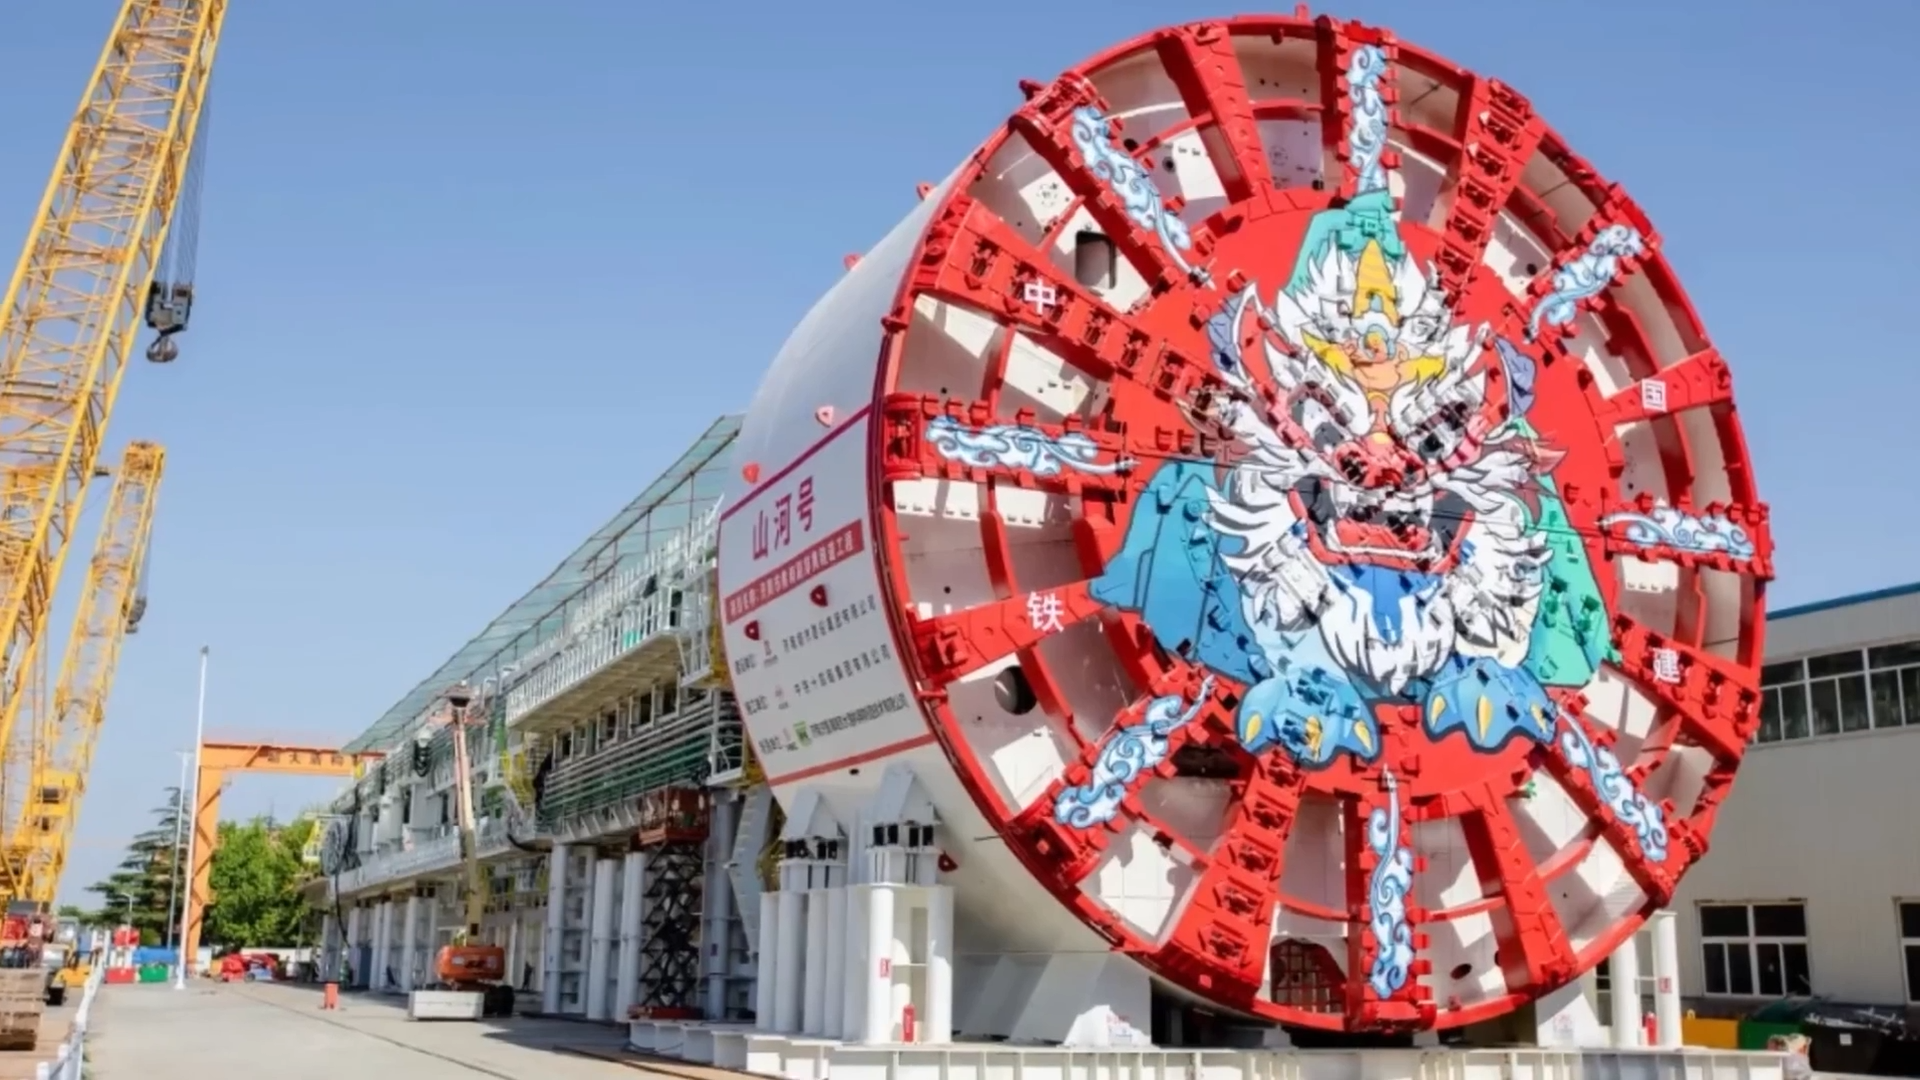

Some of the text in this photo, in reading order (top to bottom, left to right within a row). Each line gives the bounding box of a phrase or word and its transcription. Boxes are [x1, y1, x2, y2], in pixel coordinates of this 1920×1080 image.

[1024, 277, 1056, 315] 中
[1641, 378, 1667, 412] 国
[752, 475, 815, 561] 山河号
[1027, 591, 1065, 632] 铁
[1652, 647, 1681, 684] 建
